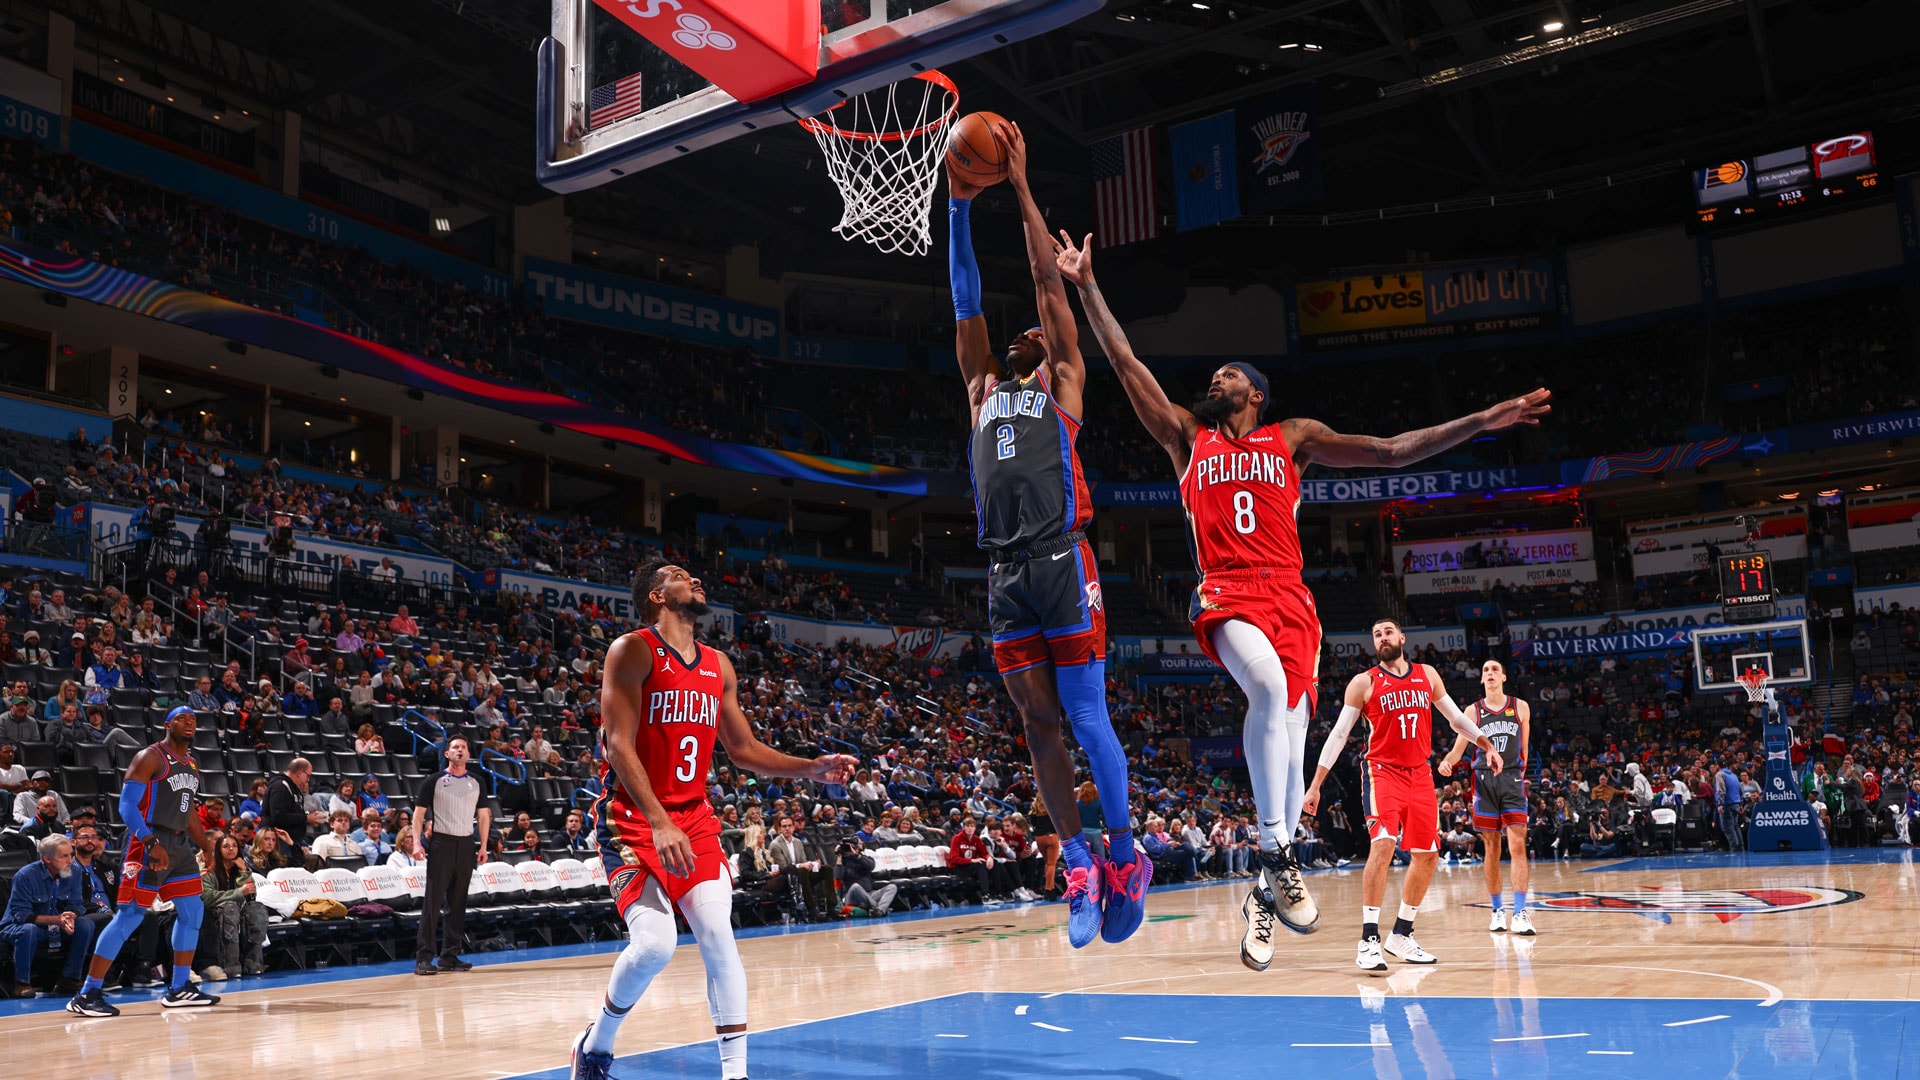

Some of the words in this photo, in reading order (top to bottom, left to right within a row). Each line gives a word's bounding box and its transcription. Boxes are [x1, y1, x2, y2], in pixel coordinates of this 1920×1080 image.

[3, 102, 49, 139] 309
[1250, 111, 1308, 141] THUNDER
[1822, 187, 1831, 196] 6
[1862, 178, 1877, 188] 66
[307, 212, 339, 241] 310
[482, 274, 508, 299] 311
[527, 270, 721, 332] THUNDER
[727, 315, 777, 341] UP
[1317, 334, 1359, 347] BRING
[1362, 330, 1390, 343] THE
[1392, 324, 1455, 340] THUNDER
[1474, 320, 1505, 333] EXIT
[1508, 316, 1541, 328] NOW
[793, 340, 822, 359] 312
[118, 365, 128, 407] 209
[996, 423, 1016, 460] 2
[1197, 451, 1286, 491] PELICANS
[1332, 480, 1382, 500] ONE
[1387, 475, 1439, 496] FOR
[1450, 468, 1518, 491] FUN!
[1233, 490, 1256, 534] 8
[96, 519, 139, 549] 106
[1524, 542, 1579, 560] TERRACE
[1730, 556, 1764, 571] 11:13
[421, 569, 450, 592] 106
[1740, 570, 1764, 591] 17
[1738, 594, 1771, 603] TISSOT
[773, 623, 787, 639] 08
[1439, 634, 1464, 649] 109
[656, 647, 665, 657] 6
[1532, 632, 1664, 656] RIVERWIND
[1160, 658, 1188, 669] YOUR
[1379, 689, 1430, 714] PELICANS
[1398, 712, 1419, 740] 17
[676, 735, 699, 783] 3
[180, 792, 190, 813] 5
[1765, 790, 1797, 801] Health
[1755, 810, 1809, 820] ALWAYS
[1755, 819, 1809, 827] ONWARD
